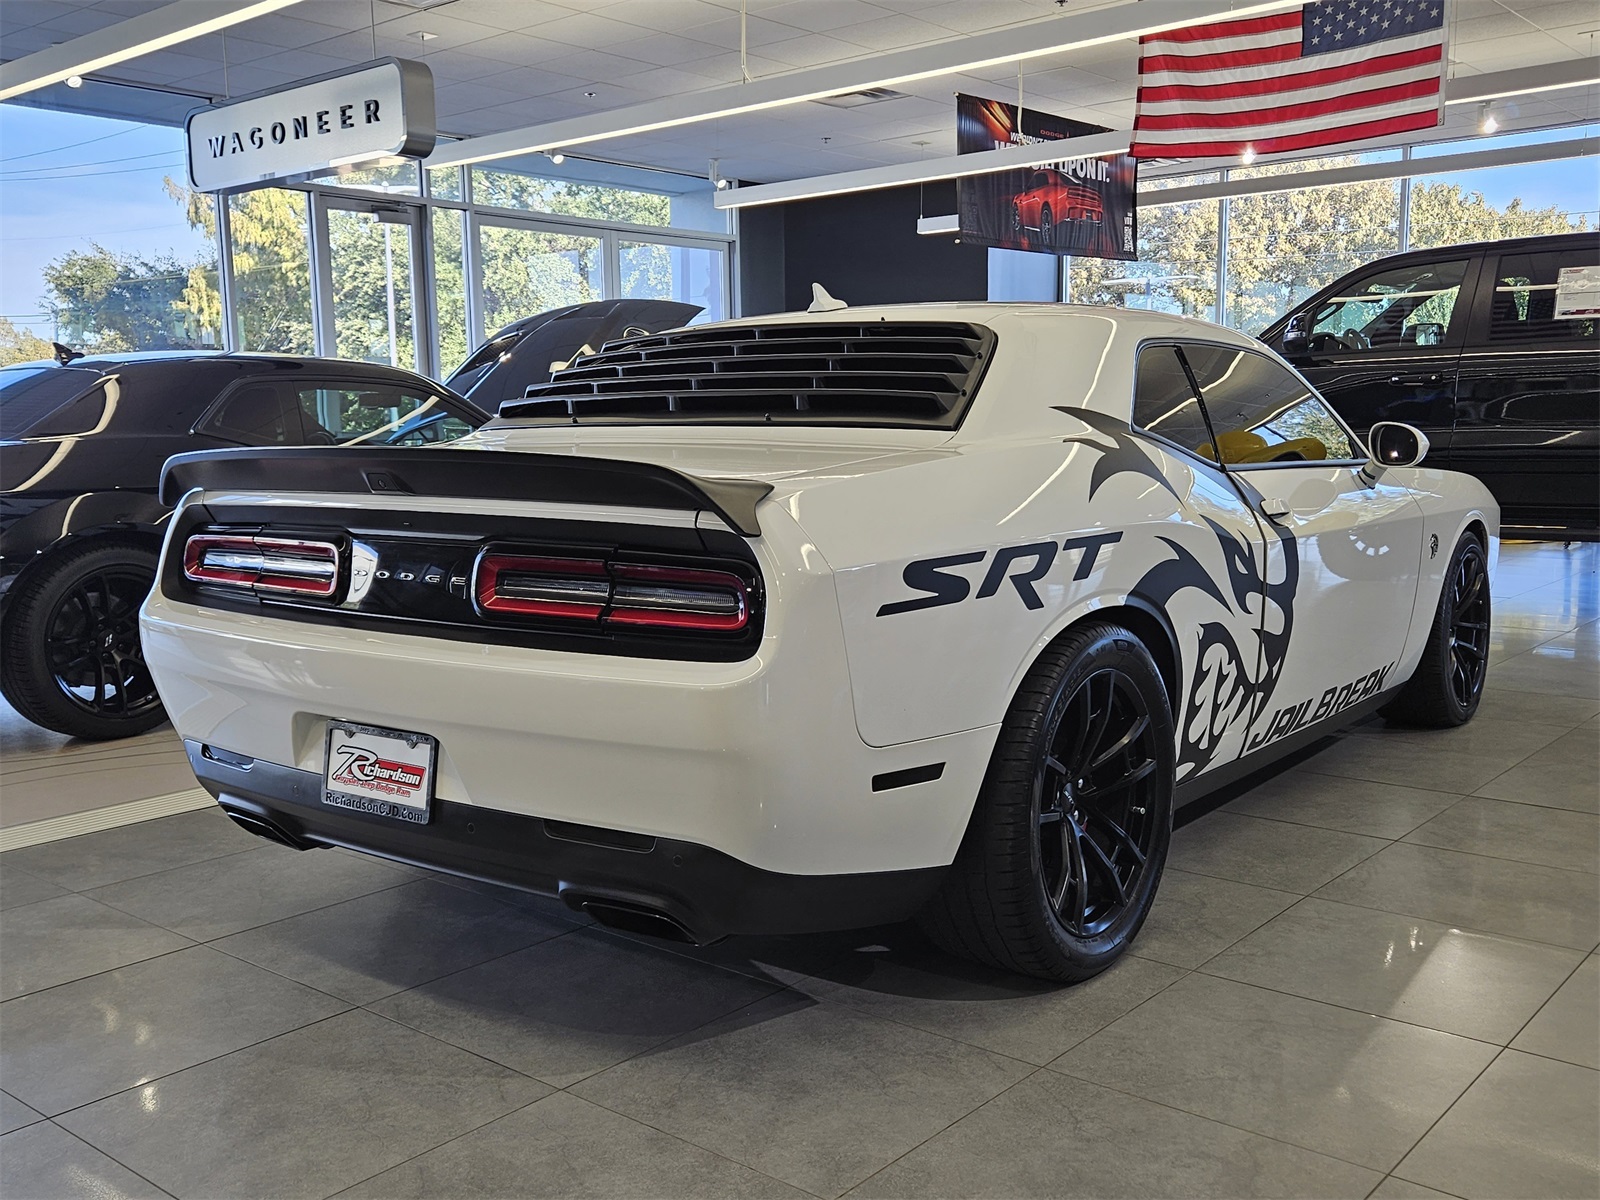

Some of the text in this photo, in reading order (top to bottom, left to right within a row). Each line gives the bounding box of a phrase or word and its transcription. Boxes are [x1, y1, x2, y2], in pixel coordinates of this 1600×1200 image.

[208, 99, 381, 158] WAGONEER
[1040, 129, 1064, 139] DODGE
[1097, 160, 1110, 183] IT.
[353, 568, 468, 587] DODGE
[875, 530, 1124, 618] SRT
[1246, 660, 1396, 752] JAILBREAK
[332, 744, 421, 786] Richardson
[325, 791, 423, 823] RichardsonCJD.com
